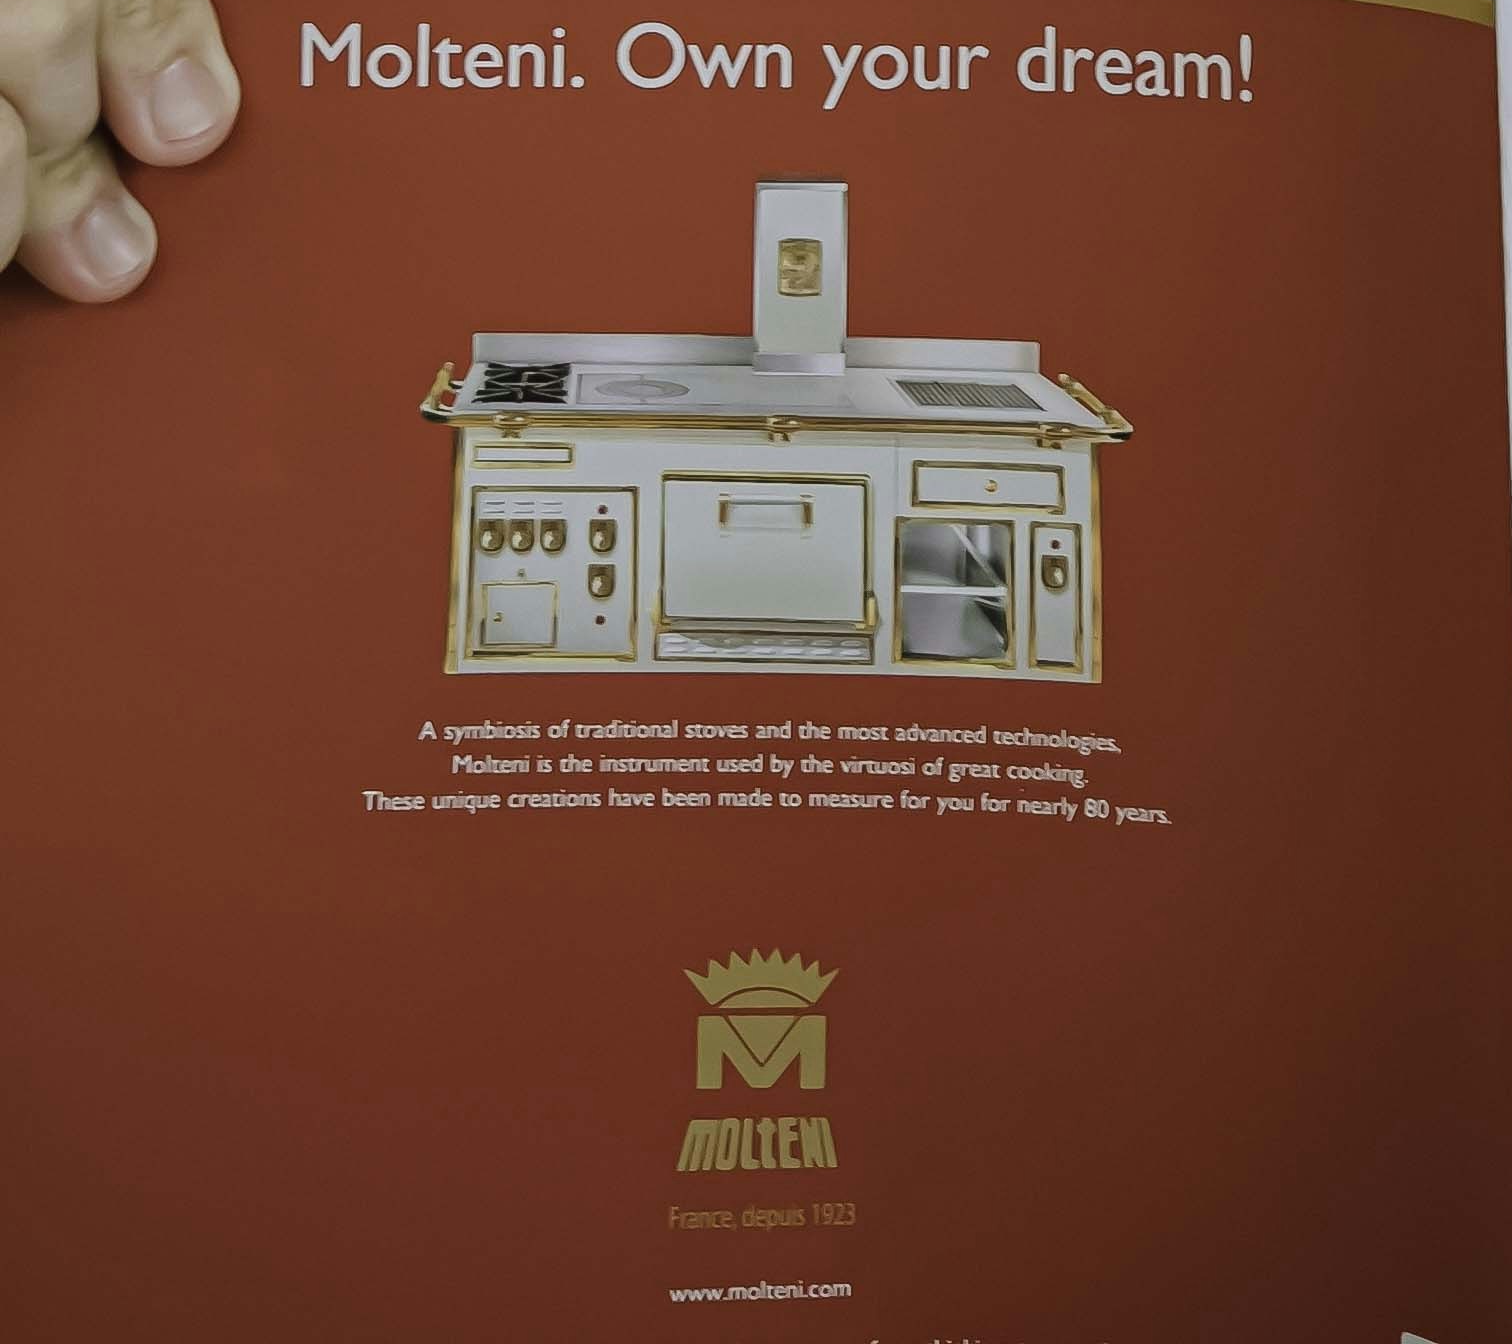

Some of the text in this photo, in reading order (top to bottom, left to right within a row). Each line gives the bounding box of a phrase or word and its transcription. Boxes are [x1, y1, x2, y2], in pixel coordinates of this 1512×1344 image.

[301, 22, 1253, 110] Molteni. Own your dream!
[417, 721, 437, 740] A
[443, 720, 540, 745] symbiosis
[547, 719, 570, 739] of
[575, 720, 679, 739] traditional
[684, 723, 748, 739] stoves
[755, 721, 791, 739] and
[799, 722, 831, 741] the
[837, 726, 888, 742] most
[895, 723, 987, 745] advanced
[452, 754, 530, 774] Molteni
[537, 754, 552, 773] is
[559, 754, 593, 773] the
[600, 754, 710, 773] instrument
[716, 754, 763, 773] used
[770, 754, 794, 778] by
[800, 754, 834, 774] the
[840, 756, 915, 775] virtuosi
[922, 757, 944, 776] of
[948, 761, 1000, 782] great
[362, 790, 425, 811] These
[431, 791, 501, 814] unique
[507, 789, 602, 808] creations
[608, 788, 655, 808] have
[662, 788, 711, 808] been
[717, 788, 773, 808] made
[779, 791, 802, 808] to
[808, 792, 894, 809] measure
[900, 789, 930, 809] for
[937, 795, 974, 815] you
[981, 792, 1011, 812] for
[1017, 795, 1078, 821] nearly
[1084, 799, 1110, 818] 80
[741, 1205, 806, 1231] depuis
[812, 1203, 856, 1226] 1923
[669, 1280, 852, 1304] www.molteni.com
